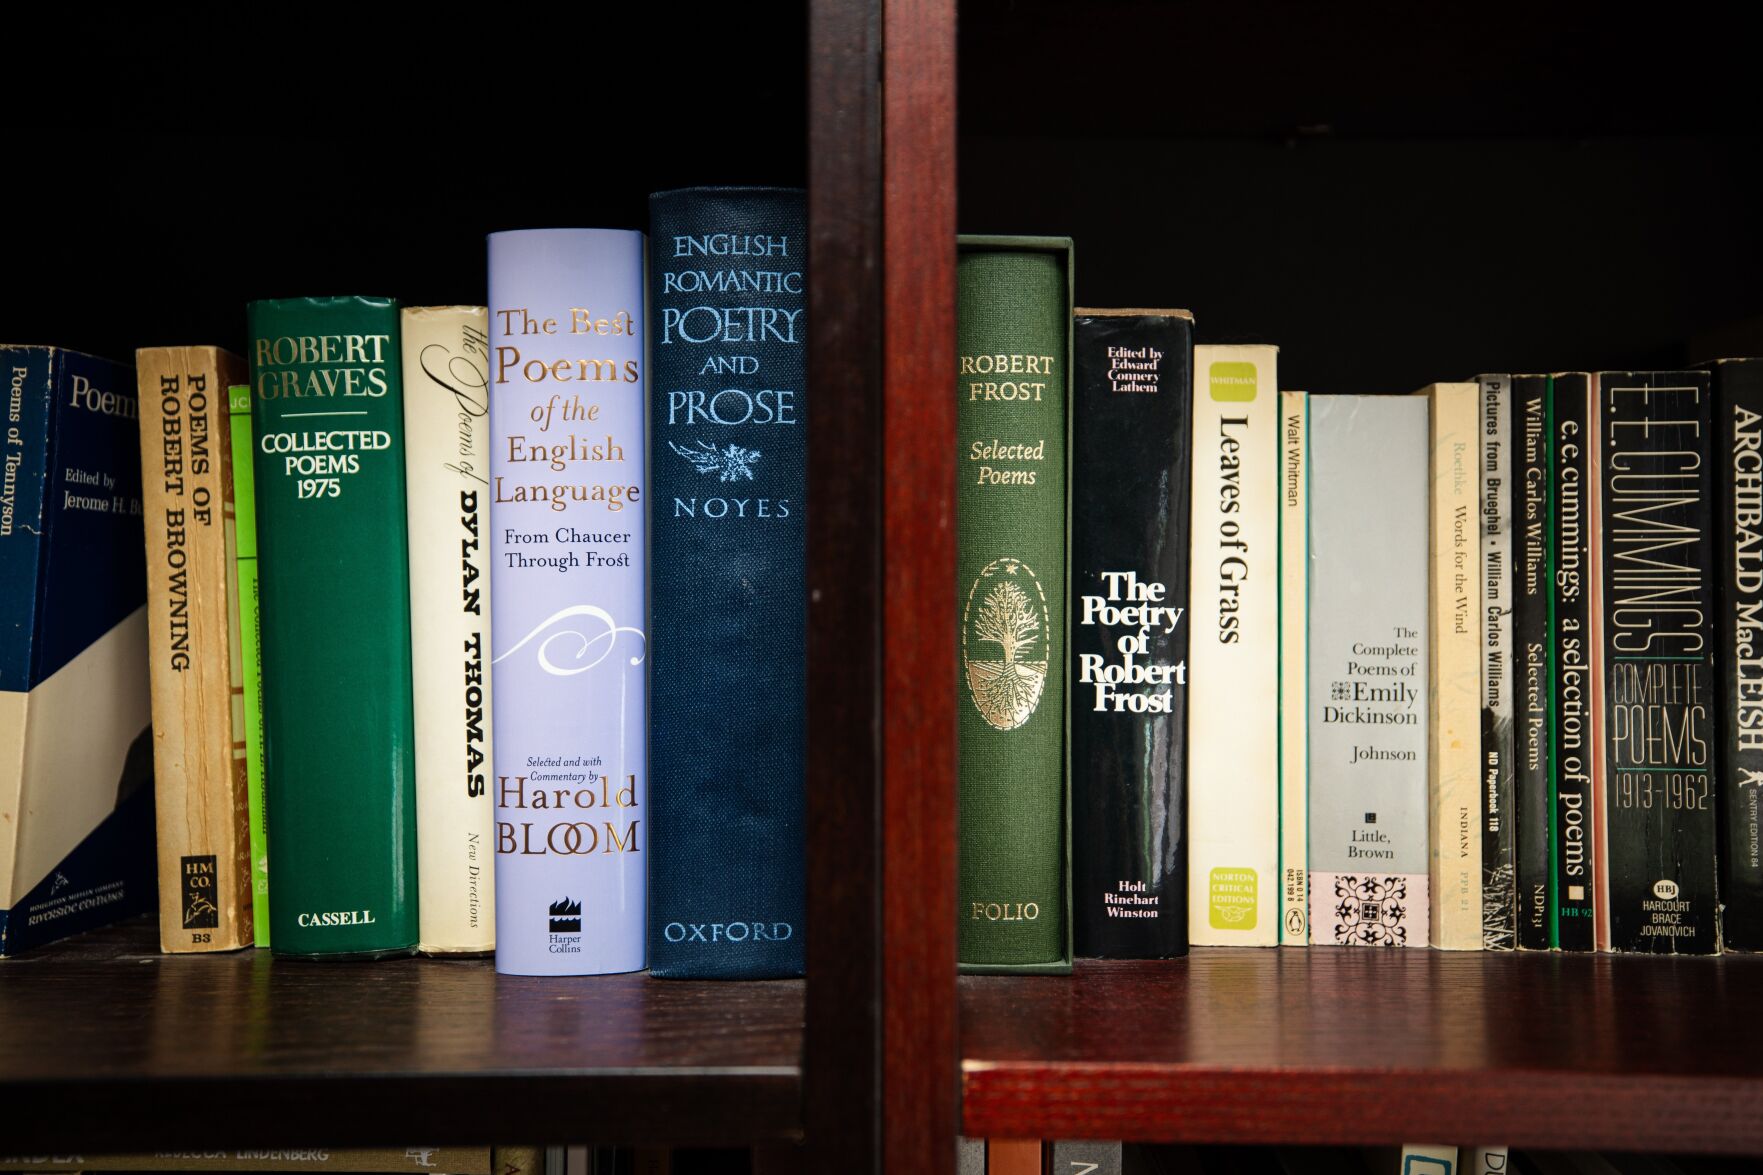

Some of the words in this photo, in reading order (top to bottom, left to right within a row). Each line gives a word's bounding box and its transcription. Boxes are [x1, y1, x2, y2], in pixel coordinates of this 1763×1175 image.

[673, 234, 788, 257] ENGLISH
[663, 271, 802, 293] ROMANTIC
[497, 309, 557, 336] The
[569, 307, 634, 336] Best
[662, 306, 803, 344] POETRY
[256, 335, 390, 367] ROBERT
[462, 325, 488, 354] the
[495, 346, 639, 384] Poems
[699, 356, 759, 375] AND
[960, 355, 1054, 375] ROBERT
[1107, 347, 1146, 359] Edited
[1149, 348, 1164, 361] by
[1111, 359, 1158, 370] Edward
[258, 368, 387, 400] GRAVES
[1107, 370, 1160, 384] Connery
[1112, 381, 1158, 393] Lathem
[1210, 377, 1256, 385] WHITMAN
[9, 366, 27, 423] Poems
[420, 343, 488, 457] Poems
[970, 382, 1045, 401] FROST
[530, 394, 560, 432] of
[561, 394, 600, 422] the
[668, 389, 796, 425] PROSE
[1486, 382, 1500, 436] Pictures
[7, 427, 23, 446] of
[160, 374, 184, 496] ROBERT
[187, 373, 210, 475] POEMS
[1287, 414, 1300, 445] Walt
[1526, 397, 1542, 463] William
[261, 431, 391, 454] COLLECTED
[507, 434, 625, 472] English
[971, 440, 1044, 460] Selected
[285, 455, 360, 475] POEMS
[1219, 414, 1249, 514] Leaves
[1454, 441, 1466, 495] Roethke
[1486, 442, 1500, 472] from
[65, 468, 100, 486] Edited
[103, 472, 116, 489] by
[444, 461, 488, 485] of
[977, 466, 1036, 485] Poems
[1288, 447, 1300, 507] Whitman
[0, 452, 22, 536] Tennyson
[63, 490, 109, 512] Jerome
[112, 497, 127, 513] H.
[298, 478, 341, 499] 1975
[494, 477, 640, 512] Language
[1526, 467, 1542, 520] Carlos
[1733, 404, 1763, 593] ARCHIBALD
[192, 486, 212, 527] OF
[674, 497, 790, 518] NOYES
[1484, 478, 1501, 535] Brueghel
[505, 529, 549, 544] From
[555, 527, 631, 544] Chaucer
[1220, 520, 1248, 553] of
[1455, 506, 1467, 548] Words
[460, 490, 480, 616] DYLAN
[505, 551, 579, 573] Through
[586, 551, 630, 567] Frost
[1455, 549, 1467, 570] for
[1526, 522, 1542, 595] Williams
[1101, 571, 1165, 602] The
[1455, 572, 1467, 593] the
[1487, 551, 1502, 601] William
[165, 508, 190, 672] BROWNING
[1219, 556, 1249, 645] Grass
[1081, 596, 1183, 634] Poetry
[1455, 594, 1468, 634] Wind
[1488, 606, 1502, 647] Carlos
[1562, 618, 1580, 632] a
[1117, 625, 1149, 654] of
[1394, 627, 1418, 638] The
[1352, 643, 1418, 659] Complete
[1079, 653, 1186, 684] Robert
[1348, 662, 1398, 676] Poems
[1400, 662, 1418, 676] of
[1488, 651, 1502, 707] Williams
[1527, 643, 1543, 712] Selected
[1736, 600, 1763, 752] MacLEISH
[1093, 682, 1172, 713] Frost
[1353, 682, 1418, 709] Emily
[1562, 638, 1590, 750] selection
[1613, 663, 1702, 705] COMPLETE
[464, 633, 484, 798] THOMAS
[1323, 706, 1418, 725] Dickinson
[1528, 718, 1543, 771] Poems
[1612, 704, 1707, 765] POEMS
[527, 756, 561, 767] Selected
[563, 756, 580, 767] and
[582, 755, 602, 766] with
[1350, 746, 1416, 764] Johnson
[1488, 751, 1499, 766] ND
[530, 771, 587, 784] Commentary
[588, 770, 599, 784] by
[1564, 757, 1590, 783] of
[498, 774, 639, 809] Harold
[1486, 769, 1500, 813] Paperbook
[1615, 773, 1708, 810] 1913-1962
[1749, 788, 1758, 815] SENTRY
[496, 820, 641, 855] BLOOM
[1352, 830, 1391, 844] Little,
[1460, 807, 1469, 858] INDIANA
[1489, 817, 1499, 832] 118
[1559, 792, 1584, 876] poems
[1750, 817, 1758, 855] EDITION
[468, 833, 480, 860] New
[1347, 845, 1394, 859] Brown
[1751, 857, 1758, 868] 84
[1118, 880, 1147, 893] Holt
[1212, 884, 1254, 892] CRITICAL
[1213, 873, 1254, 881] NORTON
[1656, 884, 1676, 895] HBJ
[469, 865, 481, 928] Directions
[1104, 893, 1159, 906] Rinehart
[1212, 895, 1255, 904] EDITIONS
[1643, 901, 1690, 912] HARCOURT
[298, 910, 376, 927] CASSELL
[972, 902, 1039, 921] FOLIO
[1107, 906, 1158, 919] Winston
[1561, 908, 1579, 917] HB
[1581, 908, 1593, 918] 92
[1652, 913, 1682, 924] BRACE
[549, 934, 581, 946] Harper
[665, 922, 793, 942] OXFORD
[1640, 925, 1695, 937] JOVANOVICH
[549, 943, 581, 954] Collins
